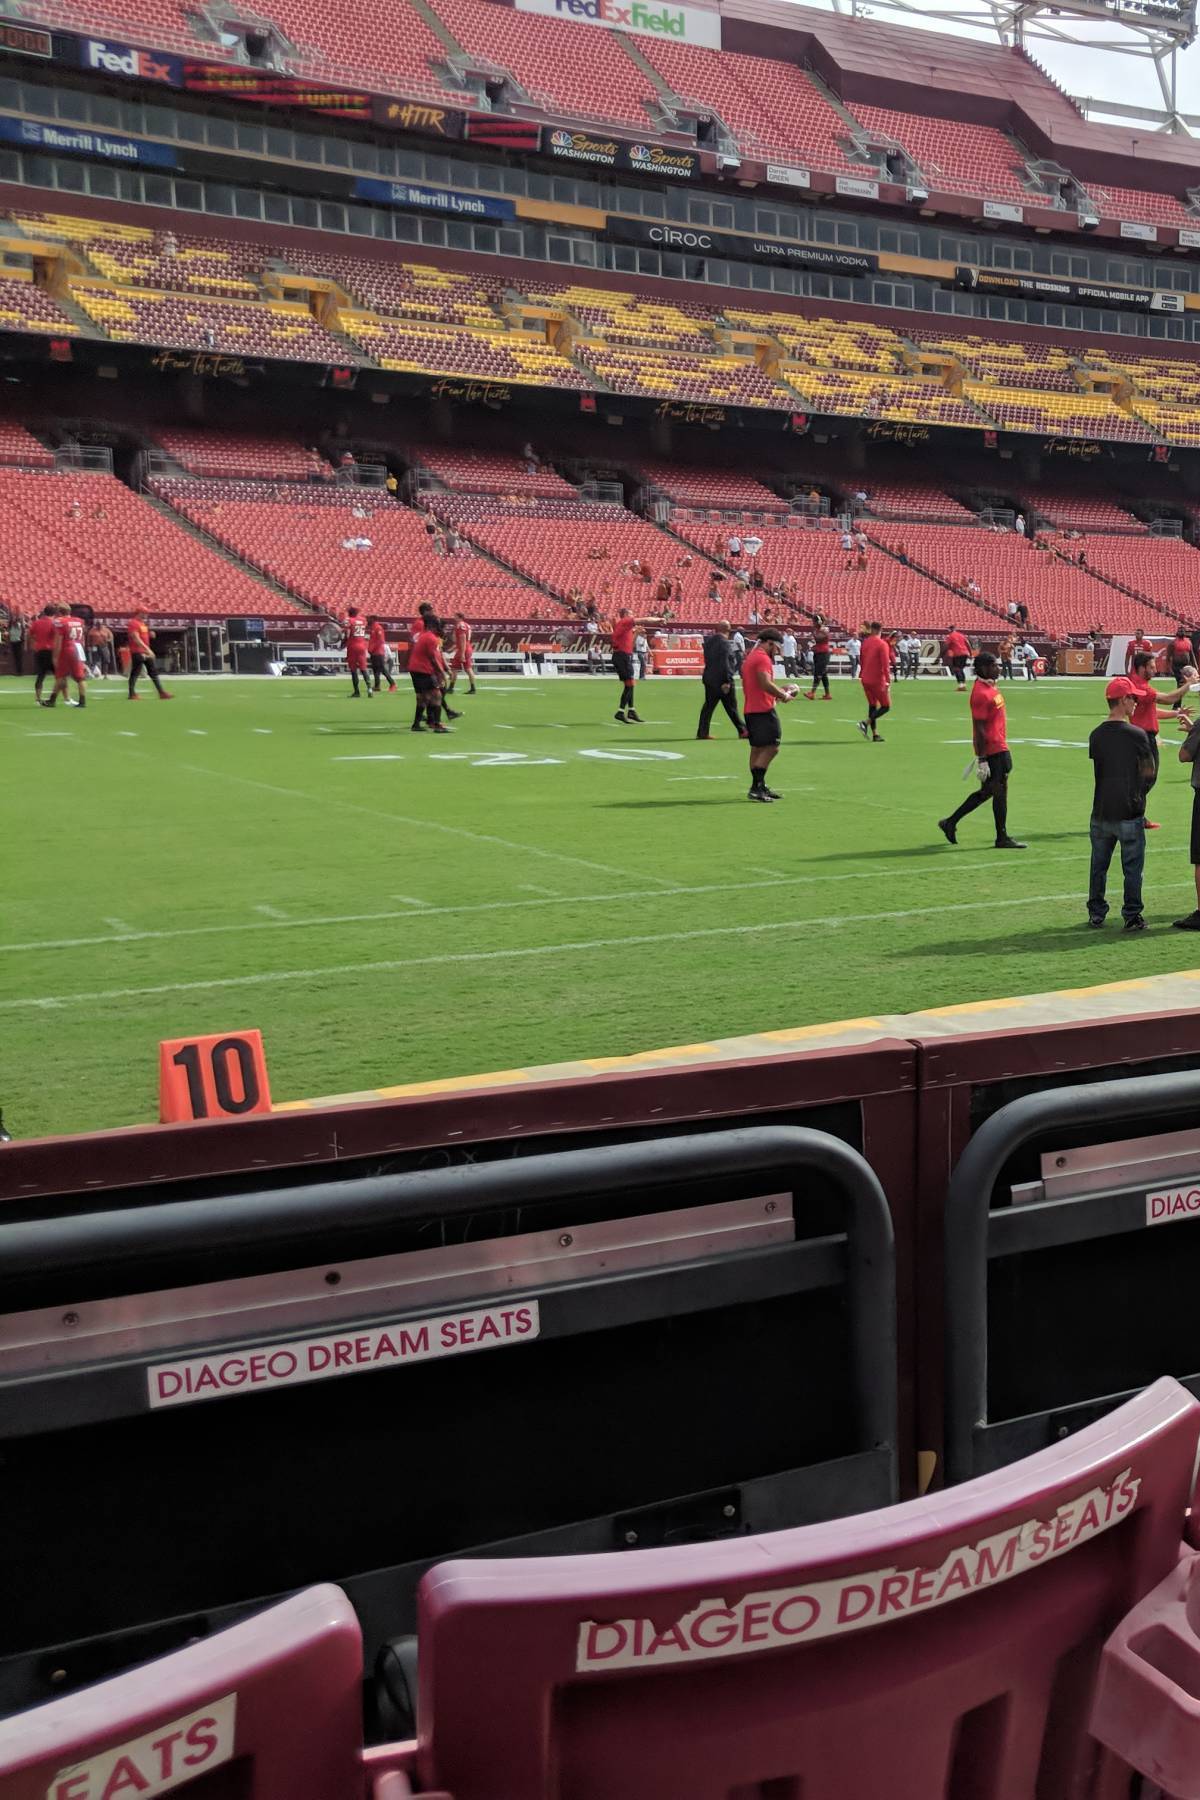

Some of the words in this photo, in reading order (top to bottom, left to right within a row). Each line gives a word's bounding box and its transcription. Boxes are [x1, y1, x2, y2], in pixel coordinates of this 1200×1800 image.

[89, 41, 170, 81] FedEx
[387, 104, 445, 132] #HTTR
[43, 128, 93, 151] Merrill
[96, 137, 138, 158] Lynch
[571, 134, 617, 157] Sports
[650, 149, 695, 170] Sports
[409, 189, 448, 209] Merrill
[451, 196, 485, 214] Lynch
[649, 226, 711, 249] CÎROC
[753, 243, 785, 256] ULTRA
[787, 248, 834, 264] PREMIUM
[836, 255, 869, 268] VODKA
[1020, 279, 1034, 289] THE
[1078, 286, 1109, 298] OFFICIAL
[1109, 291, 1135, 303] MOBILE
[1135, 294, 1149, 303] APP
[69, 626, 83, 641] 47
[665, 656, 700, 665] GATORADE
[172, 1037, 259, 1119] 10
[156, 1350, 298, 1400] DIAGEO
[307, 1326, 430, 1372] DREAM
[440, 1308, 532, 1349] SEATS
[585, 1595, 820, 1661] DIAGEO
[838, 1536, 1018, 1625] DREAM
[1027, 1478, 1140, 1561] SEATS
